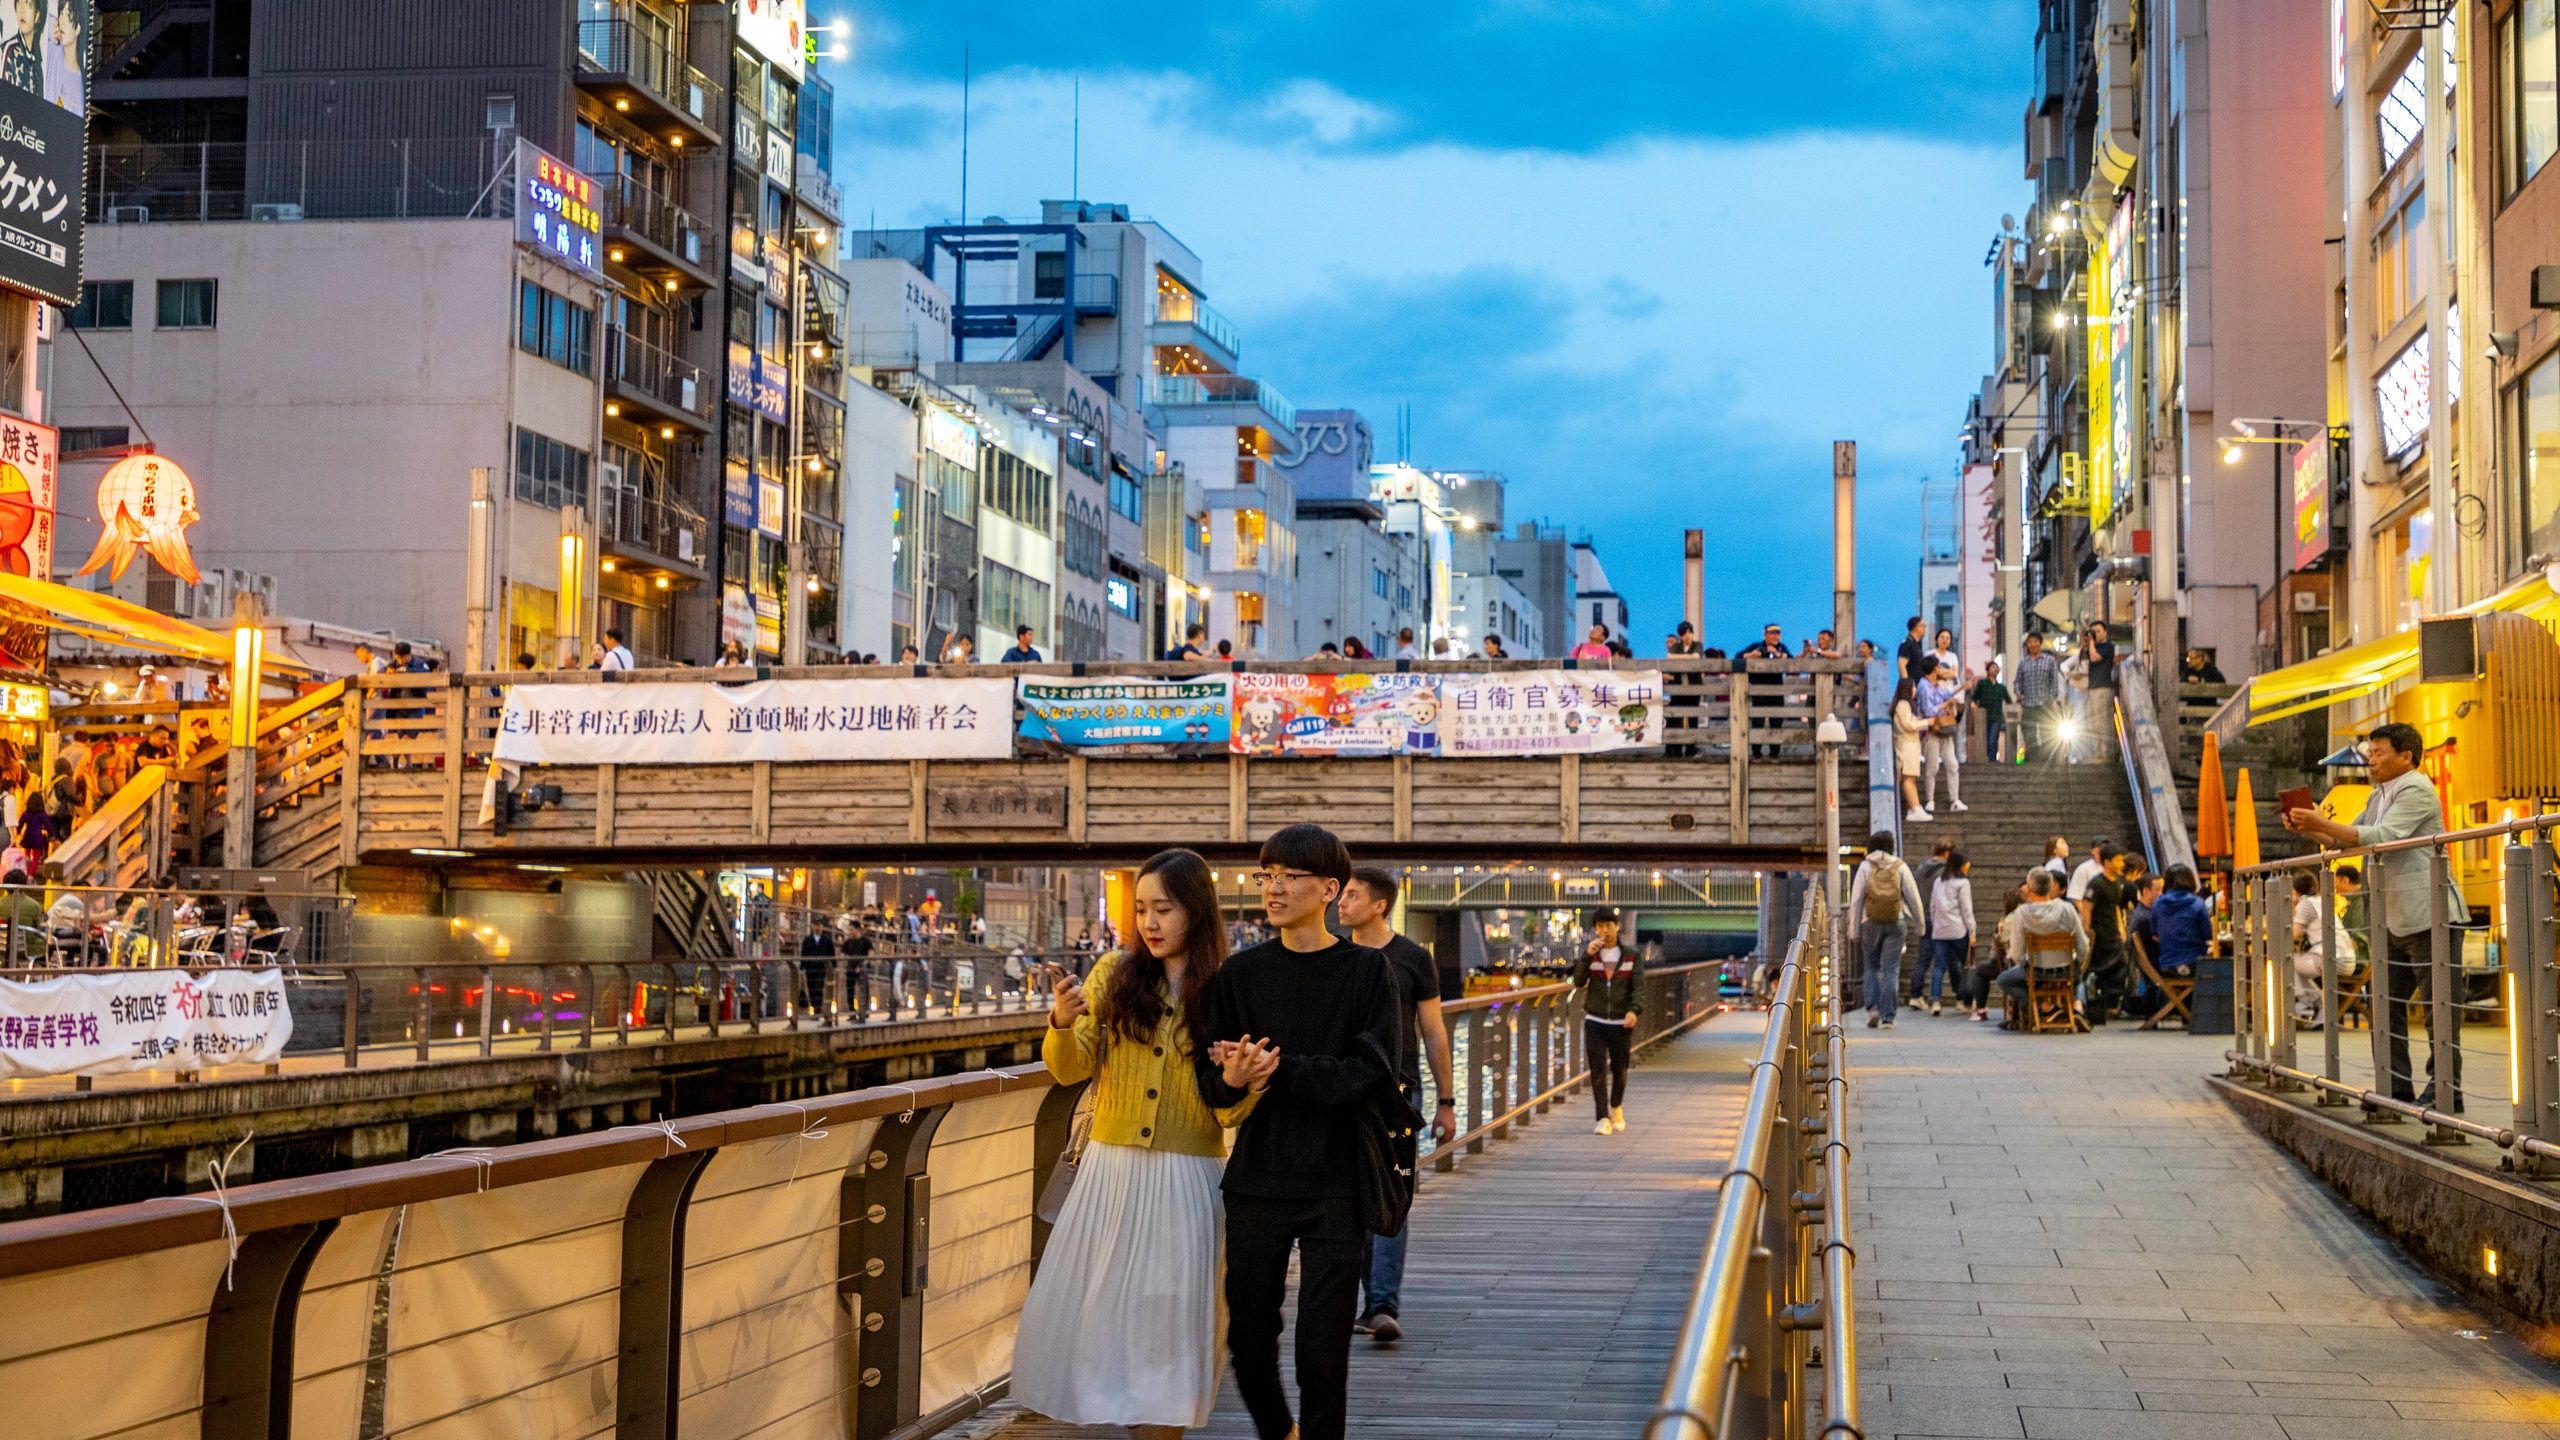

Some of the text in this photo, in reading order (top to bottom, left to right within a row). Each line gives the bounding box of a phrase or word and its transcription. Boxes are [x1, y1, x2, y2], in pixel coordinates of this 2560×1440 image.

[13, 130, 46, 154] AGE
[1242, 675, 1305, 688] 火の用心
[1457, 684, 1652, 711] 自衛官募集中
[727, 703, 978, 735] 道頓堀水辺地権者会
[1285, 718, 1326, 734] Call 119
[110, 992, 167, 1025] 令和四年
[172, 980, 203, 1020] 祝
